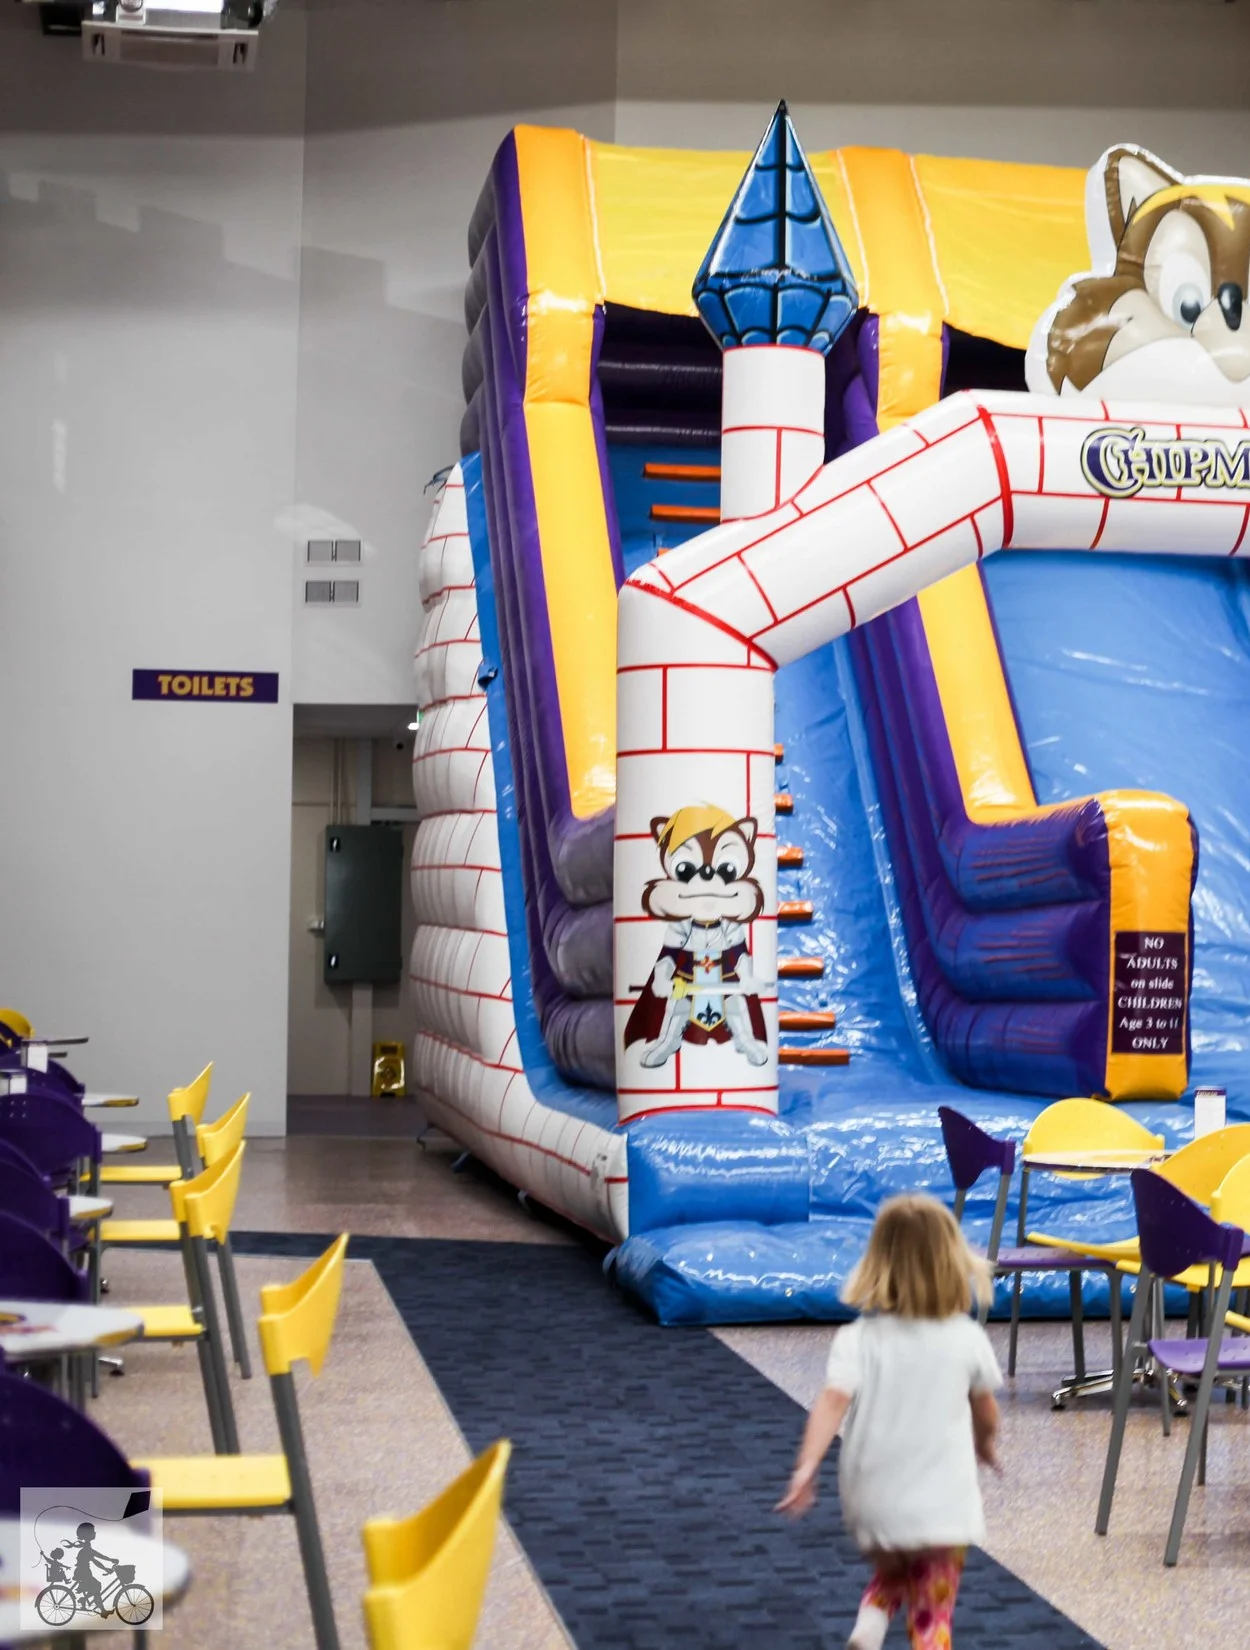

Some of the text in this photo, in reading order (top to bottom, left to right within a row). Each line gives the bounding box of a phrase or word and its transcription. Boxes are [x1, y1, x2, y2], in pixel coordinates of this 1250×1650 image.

[157, 674, 255, 697] TOILETS
[1144, 937, 1164, 950] NO
[1126, 957, 1178, 970] ADULTS
[1130, 977, 1174, 990] on slide
[1118, 996, 1182, 1009] CHILDREN
[1119, 1017, 1143, 1031] Age
[1145, 1017, 1153, 1029] 3
[1156, 1018, 1167, 1029] to
[1132, 1037, 1169, 1049] ONLY
